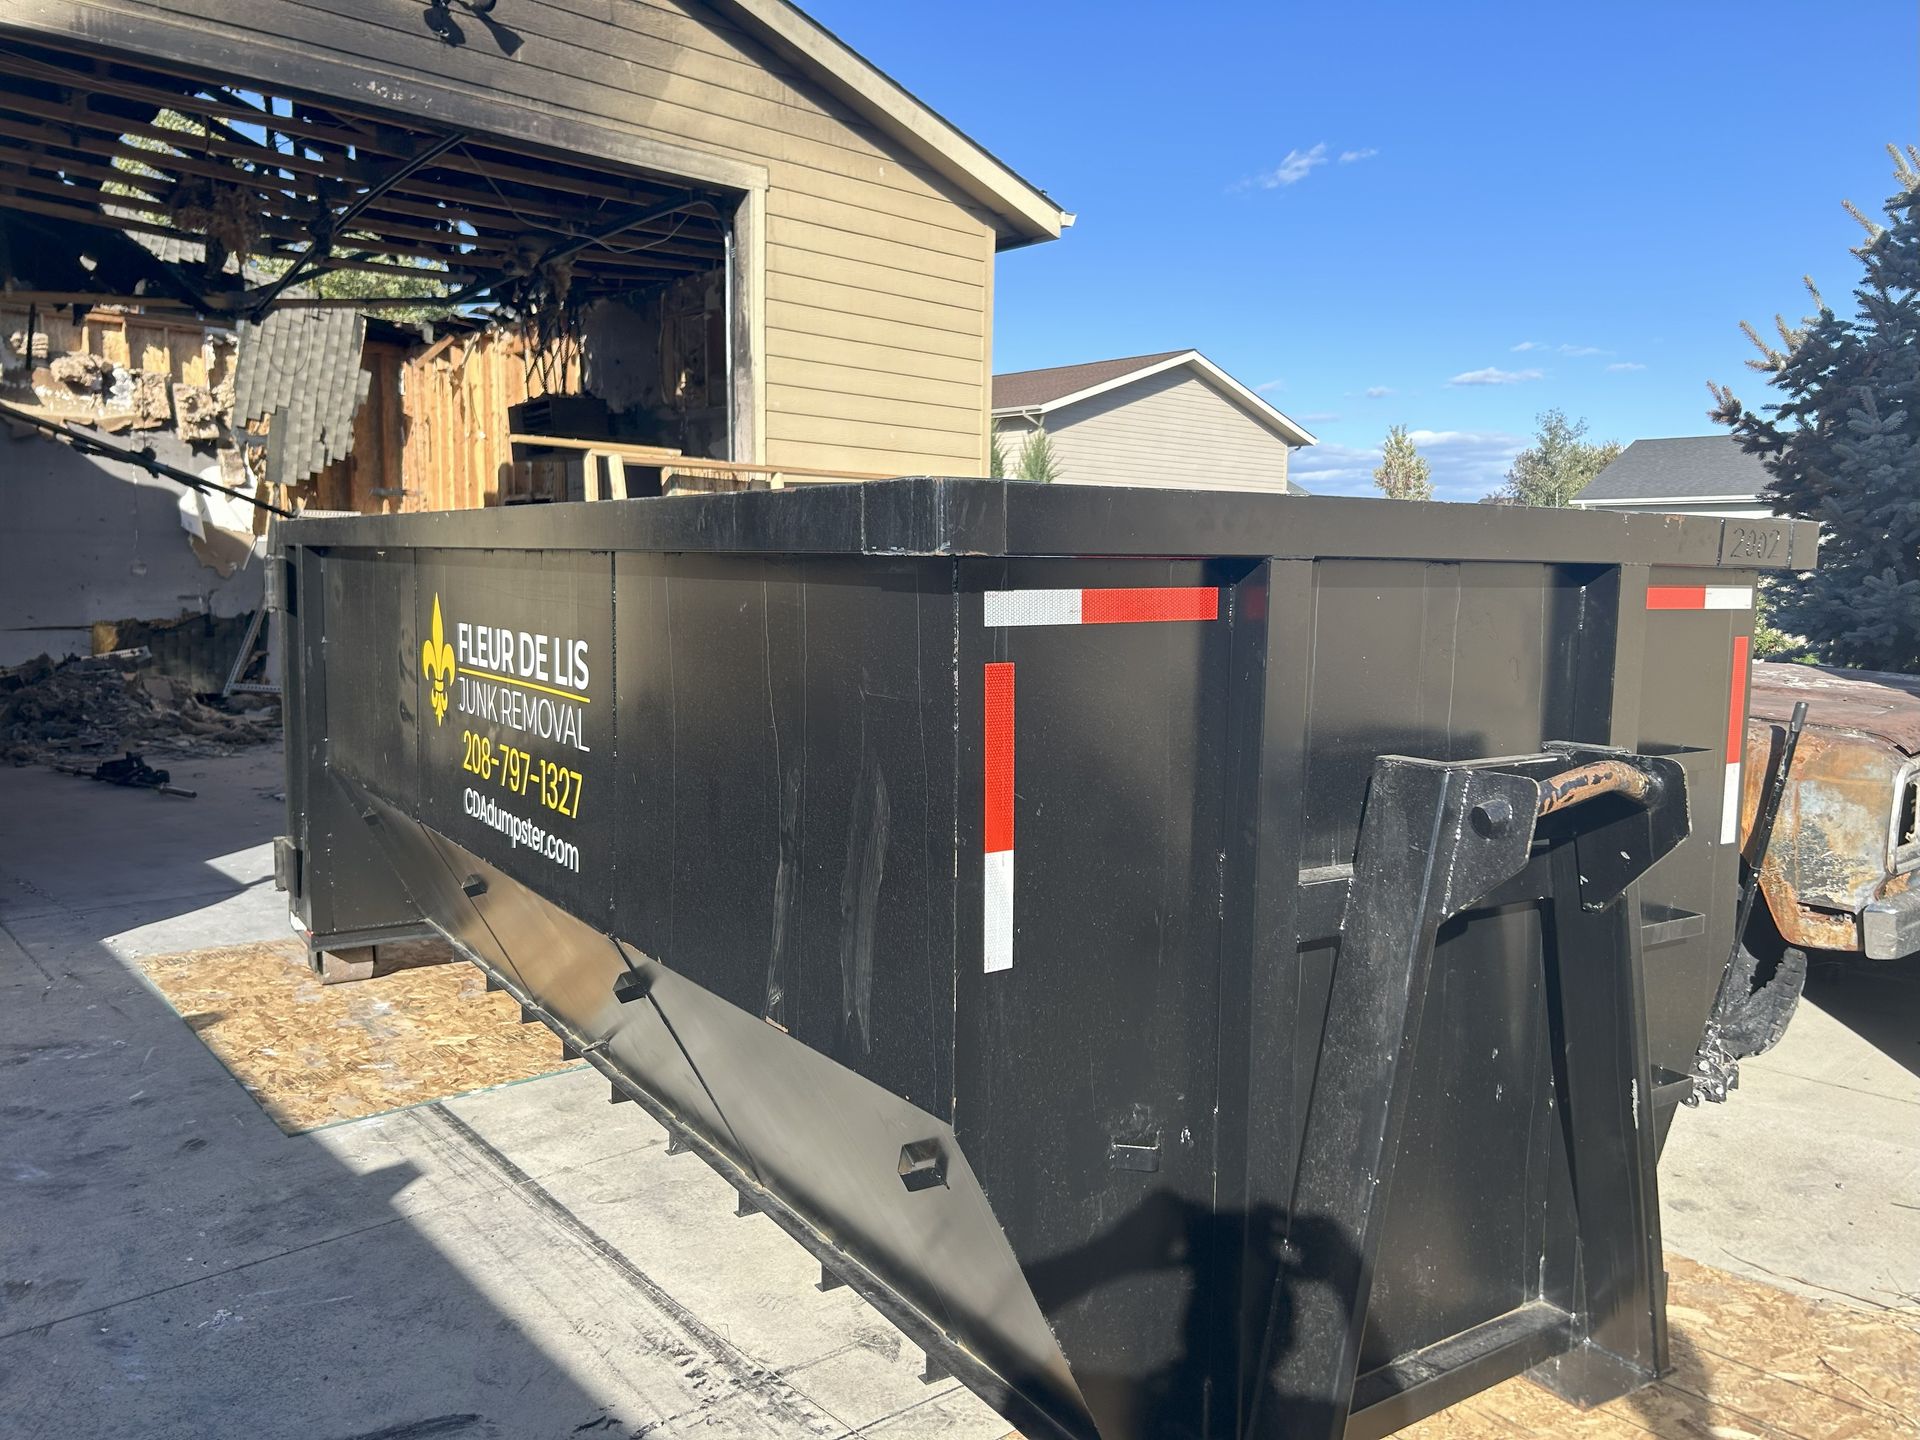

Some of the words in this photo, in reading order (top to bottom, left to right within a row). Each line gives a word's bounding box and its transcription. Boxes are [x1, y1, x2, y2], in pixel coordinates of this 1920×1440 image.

[457, 622, 514, 674] FLEUR
[519, 632, 549, 682] DE
[554, 637, 589, 691] LIS
[458, 676, 498, 723] JUNK
[501, 688, 590, 752] REMOVAL
[463, 729, 583, 819] 208-797-1327
[464, 787, 580, 873] CDAdumpster.com
